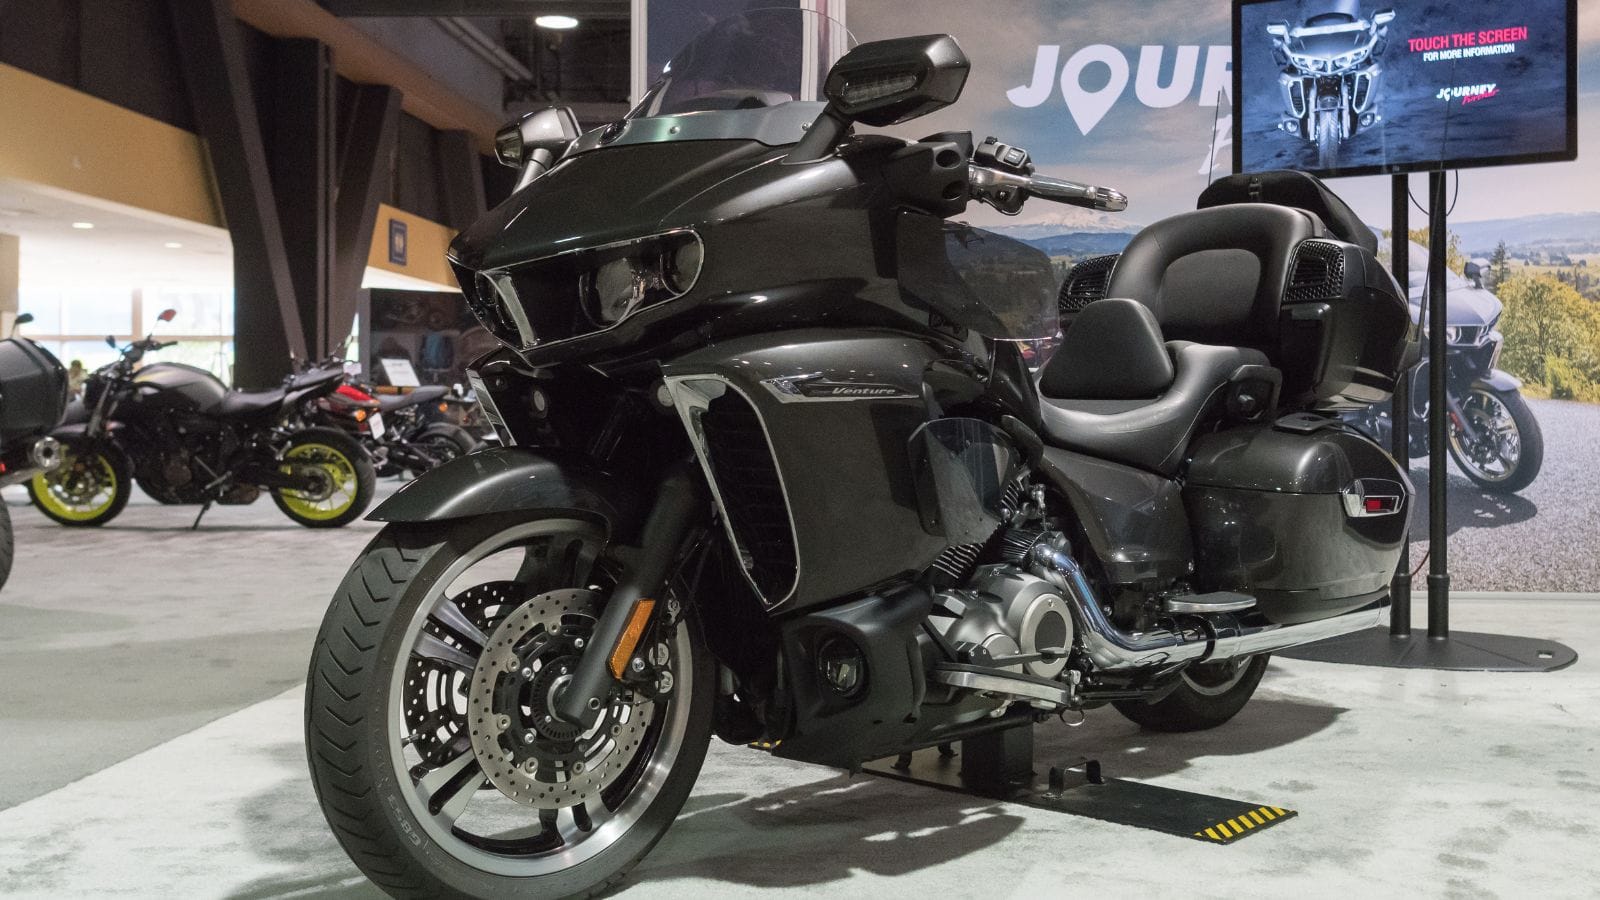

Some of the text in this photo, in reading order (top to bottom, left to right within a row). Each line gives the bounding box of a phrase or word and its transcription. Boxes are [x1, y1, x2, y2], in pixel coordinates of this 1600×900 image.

[1408, 26, 1527, 52] TOUCH THE SCREEN
[1423, 43, 1515, 61] FOR MORE INFORMATION
[1436, 83, 1496, 101] JOURNEY
[832, 387, 896, 395] Venture
